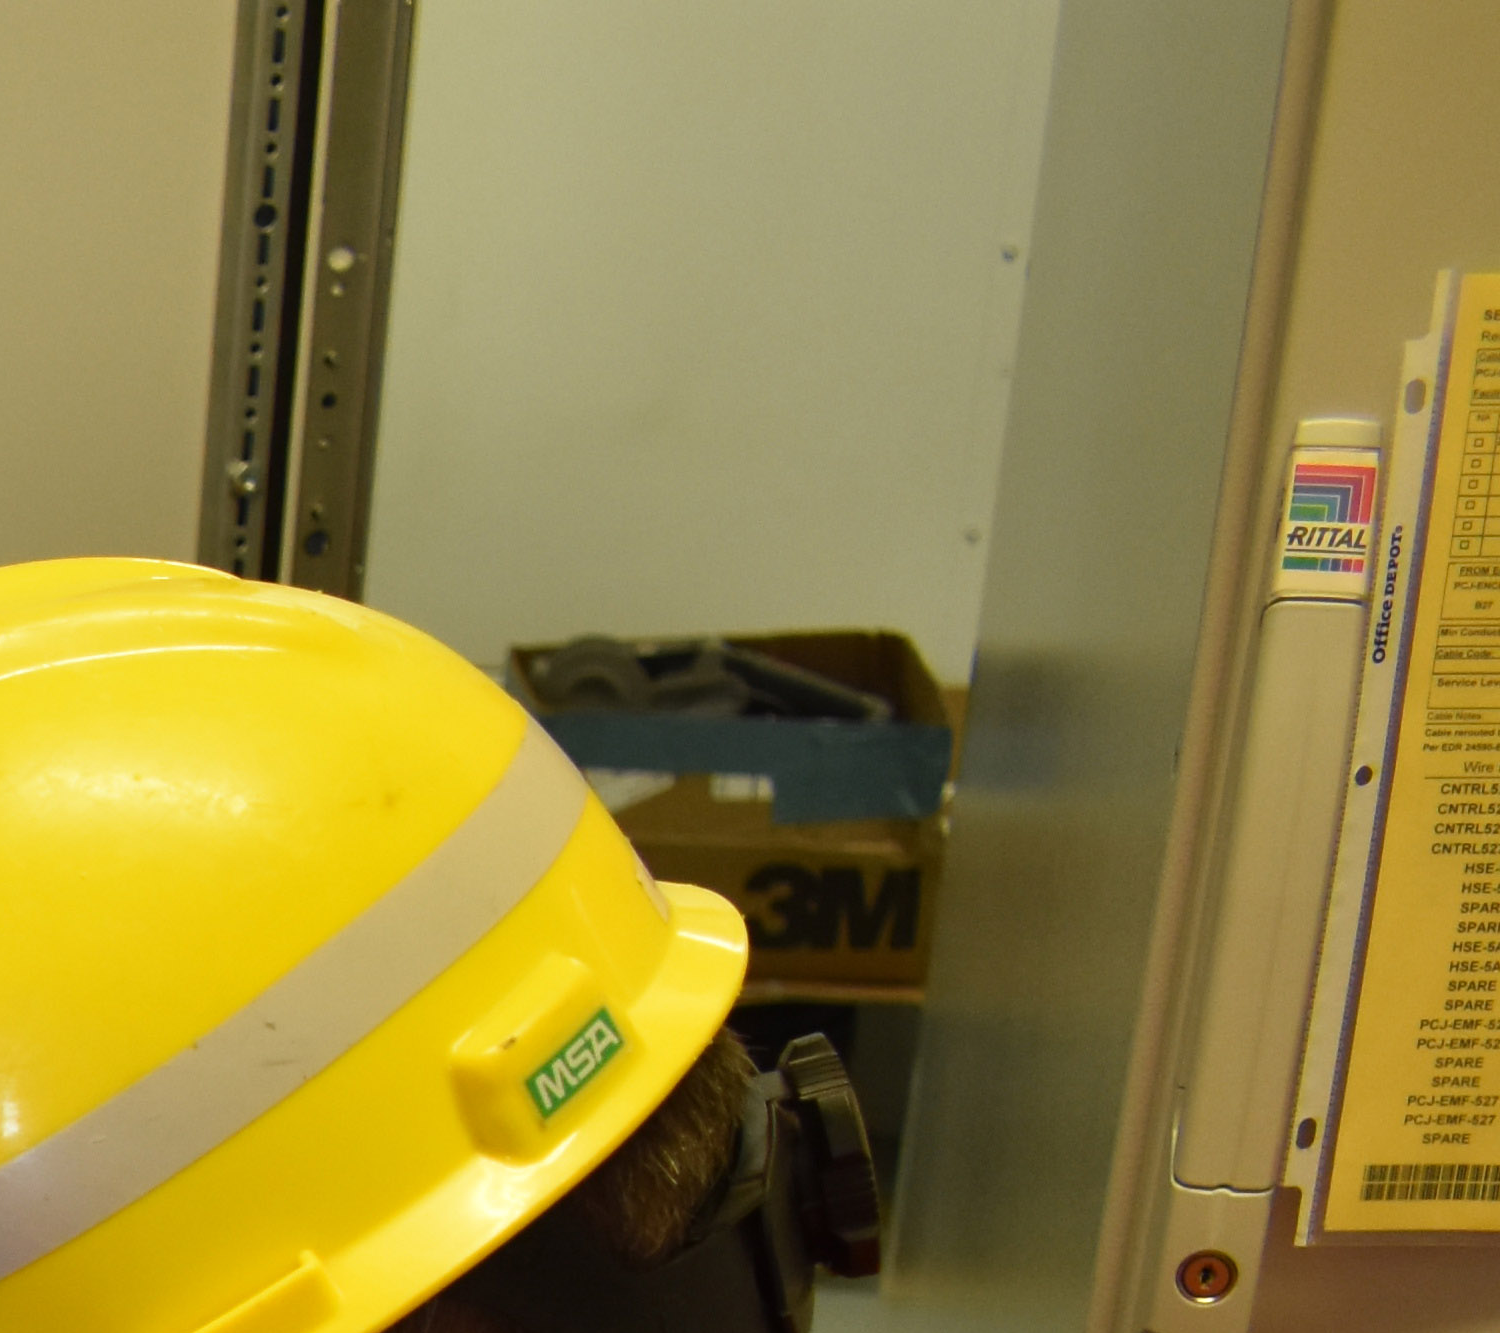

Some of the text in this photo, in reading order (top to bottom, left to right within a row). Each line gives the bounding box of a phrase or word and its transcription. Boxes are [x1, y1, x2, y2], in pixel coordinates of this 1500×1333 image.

[1287, 526, 1367, 548] RITTAL
[1372, 600, 1392, 664] Office
[1463, 762, 1494, 772] Wire
[1441, 783, 1500, 795] CNTRL5
[1434, 823, 1500, 835] CNTRL52
[744, 862, 920, 951] 3M
[1448, 980, 1498, 992] SPARE
[1444, 999, 1494, 1011] SPARE
[534, 1020, 622, 1107] MSA
[1435, 1057, 1484, 1069] SPARE
[1431, 1076, 1481, 1088] SPARE
[1422, 1133, 1471, 1145] SPARE
